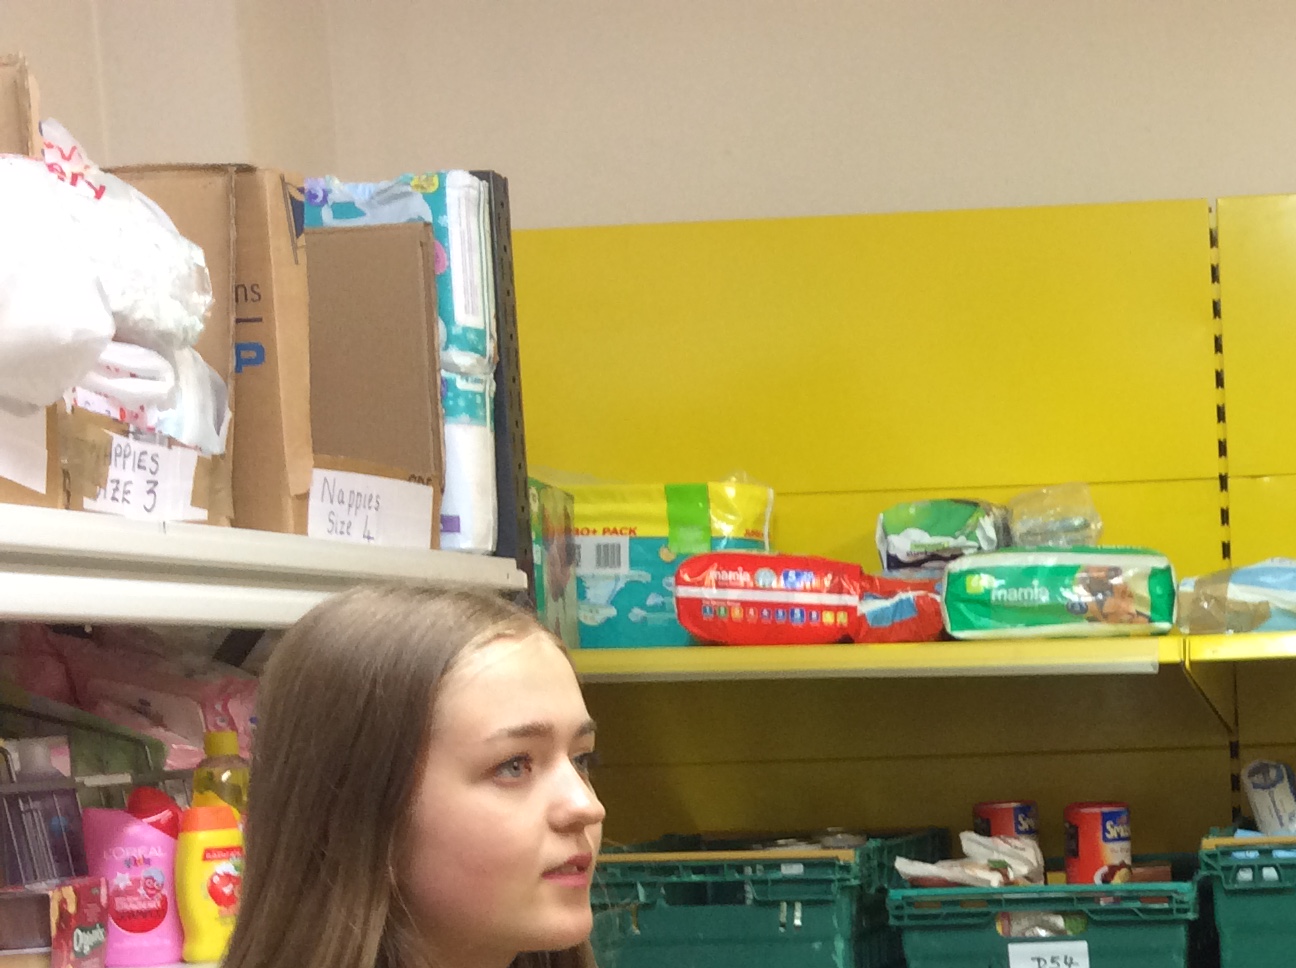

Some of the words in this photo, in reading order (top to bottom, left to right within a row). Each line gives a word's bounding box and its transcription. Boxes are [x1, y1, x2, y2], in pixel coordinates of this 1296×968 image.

[113, 443, 160, 476] PPIES
[143, 479, 159, 513] 3
[320, 476, 380, 516] Nappies
[327, 510, 352, 536] Size
[362, 515, 375, 542] 4
